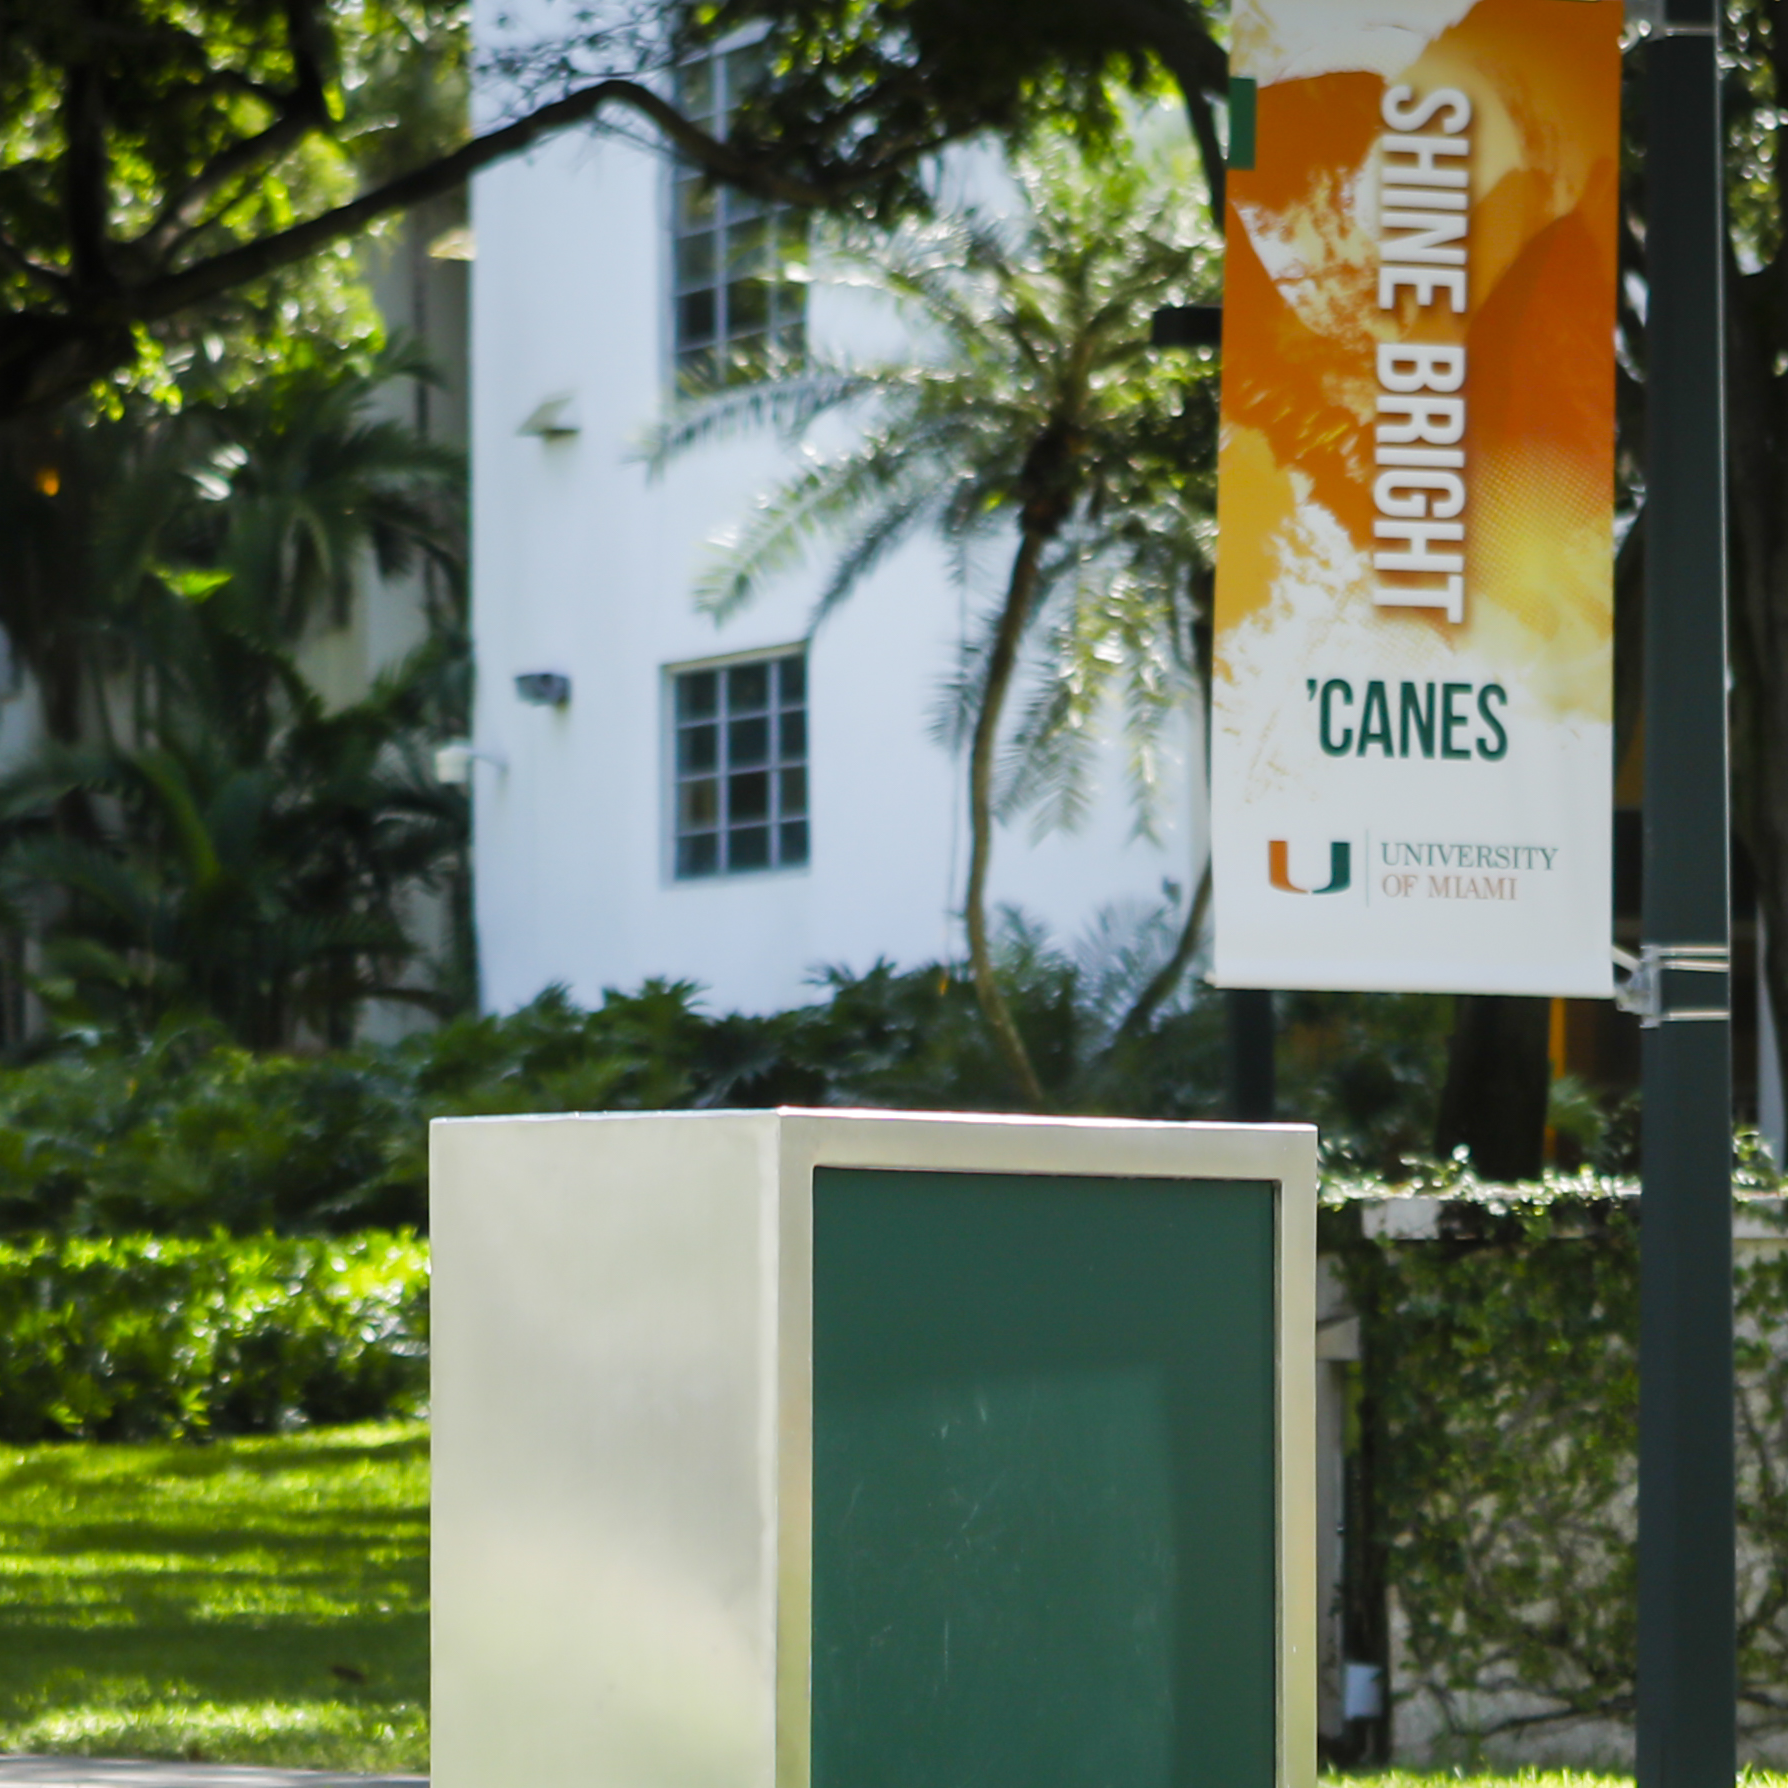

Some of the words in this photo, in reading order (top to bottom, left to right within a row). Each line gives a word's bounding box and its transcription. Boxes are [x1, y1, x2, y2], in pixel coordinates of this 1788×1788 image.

[1380, 84, 1471, 313] SHINE
[1372, 343, 1466, 624] BRIGHT
[1268, 840, 1351, 895] U
[1380, 841, 1559, 870] UNIVERSITY
[1381, 873, 1418, 899] OF
[1427, 875, 1518, 901] MIAMI
